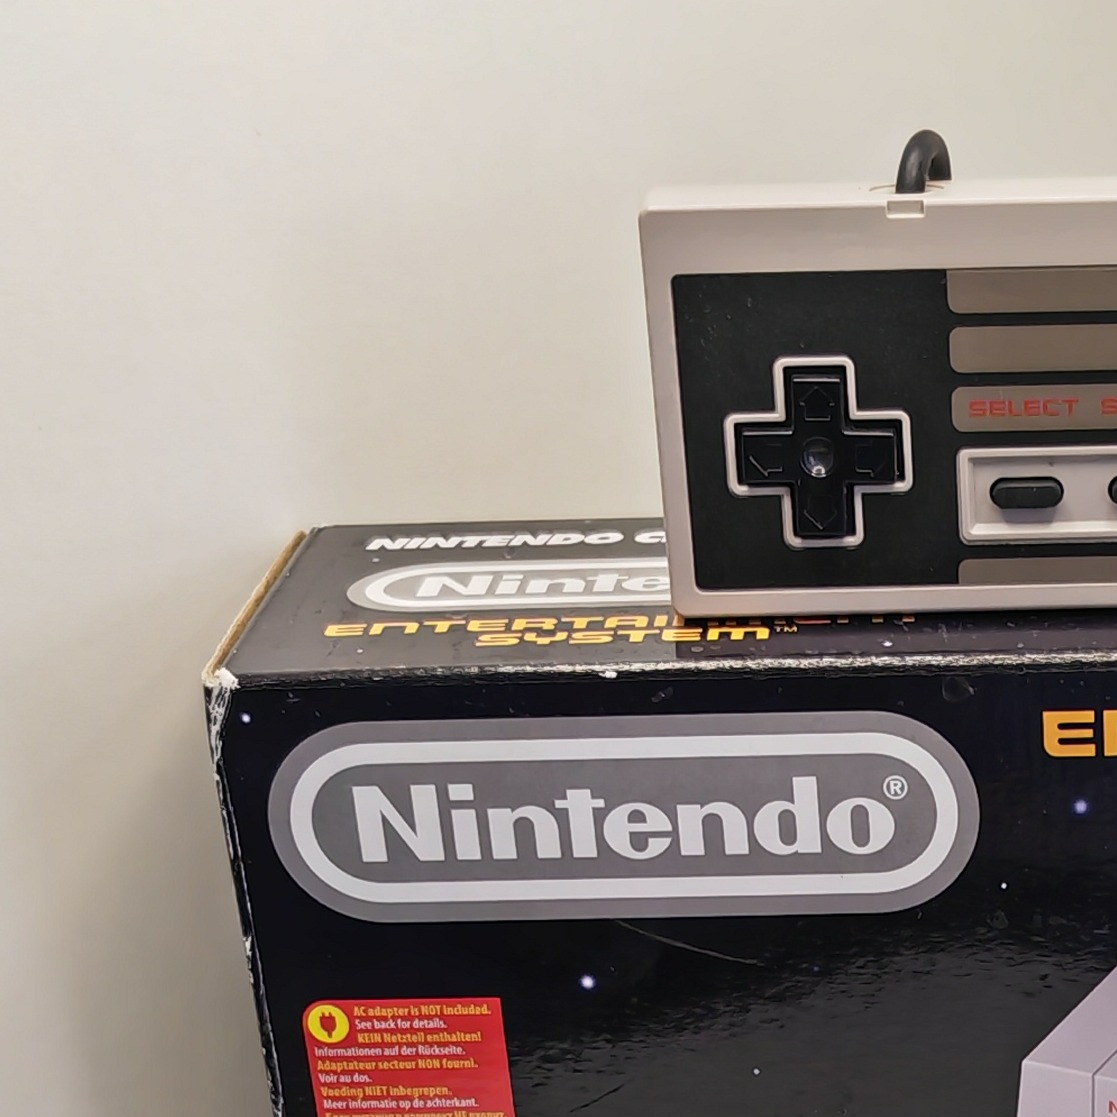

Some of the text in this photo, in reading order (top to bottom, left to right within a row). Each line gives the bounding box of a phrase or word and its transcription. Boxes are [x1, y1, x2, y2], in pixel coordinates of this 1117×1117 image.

[969, 398, 1079, 418] SELECT
[364, 532, 624, 550] NINTENDO
[353, 1005, 492, 1019] AC adapter is NOT included.
[356, 1019, 447, 1030] See back for details.
[315, 1046, 466, 1057] Informationen auf der Rückseite.
[319, 1073, 372, 1084] Voir au dos.
[324, 1098, 479, 1112] Meer informatie op de achterkant.
